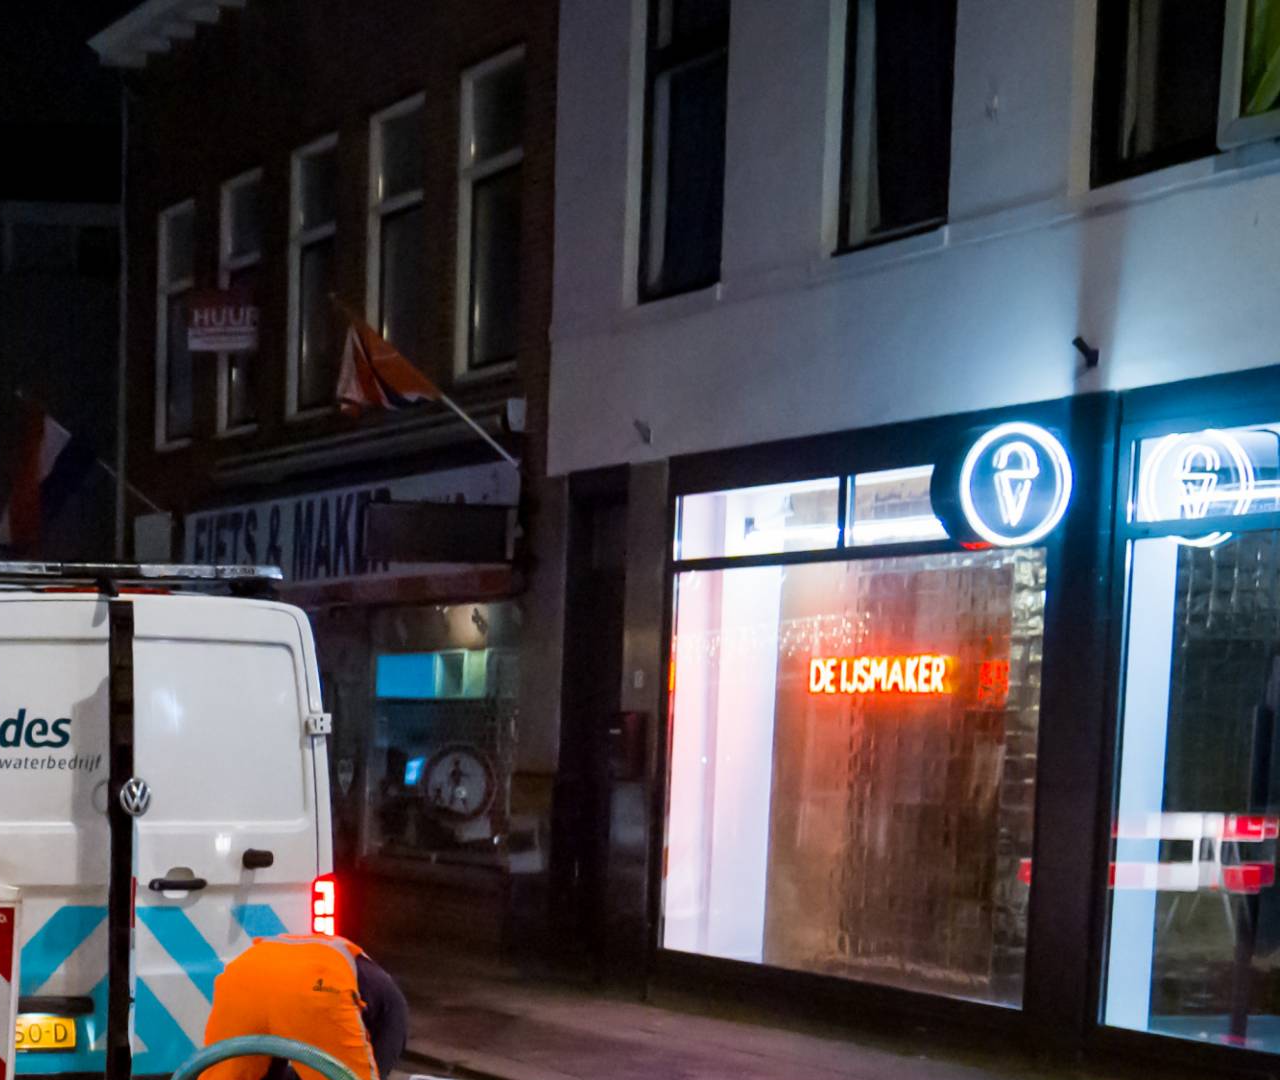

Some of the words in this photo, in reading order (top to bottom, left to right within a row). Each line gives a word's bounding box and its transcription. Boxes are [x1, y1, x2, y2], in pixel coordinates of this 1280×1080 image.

[195, 508, 258, 565] FIETS
[809, 658, 837, 693] DE
[840, 654, 946, 693] IJSMAKER
